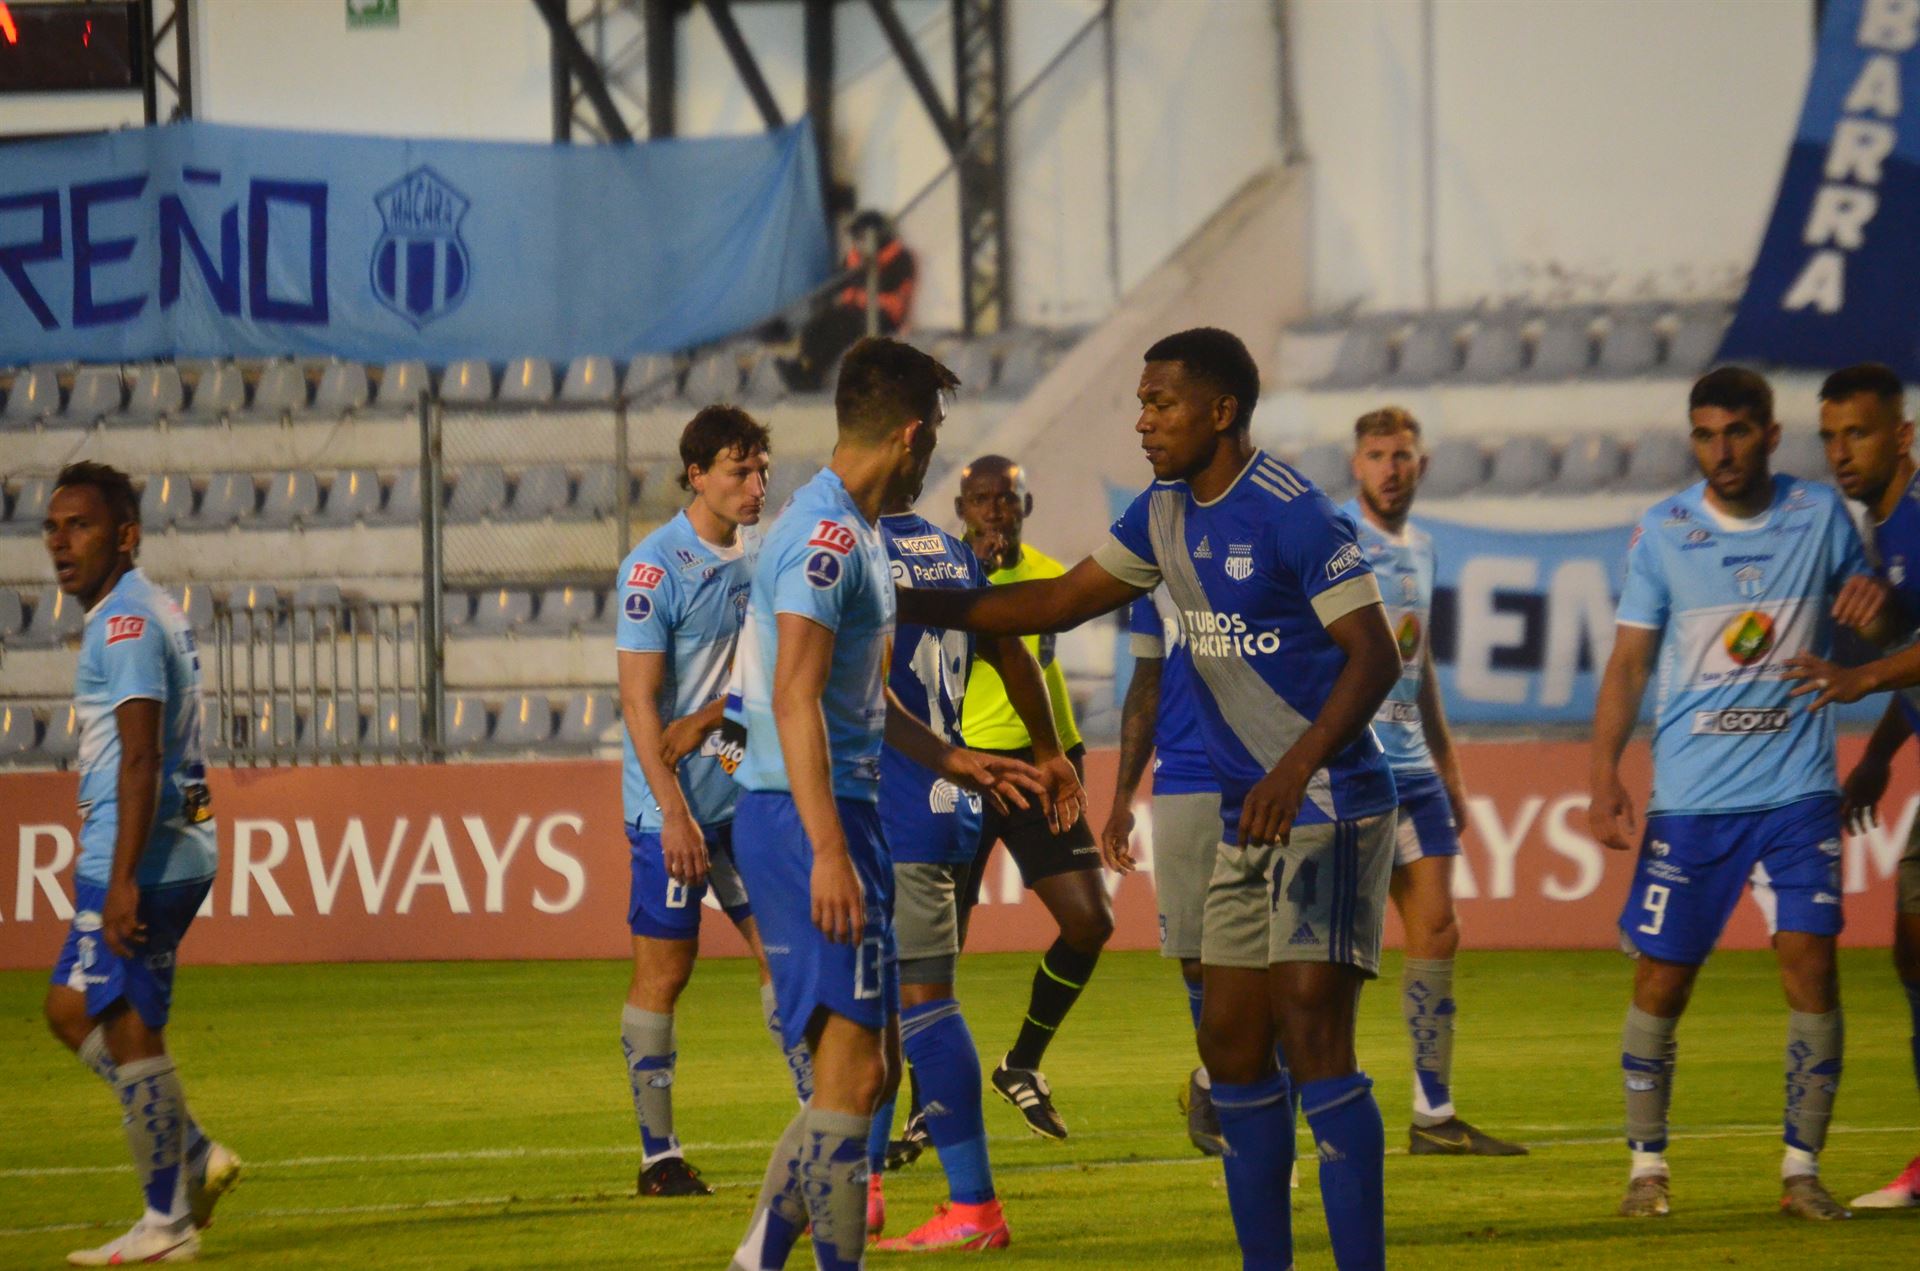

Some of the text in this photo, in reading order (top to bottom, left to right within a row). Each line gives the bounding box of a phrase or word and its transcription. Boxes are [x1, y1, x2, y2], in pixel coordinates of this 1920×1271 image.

[913, 560, 969, 581] PacifiCard
[1184, 610, 1247, 634] TUBOS
[1190, 631, 1280, 657] PACIFICO
[1637, 883, 1671, 936] 9
